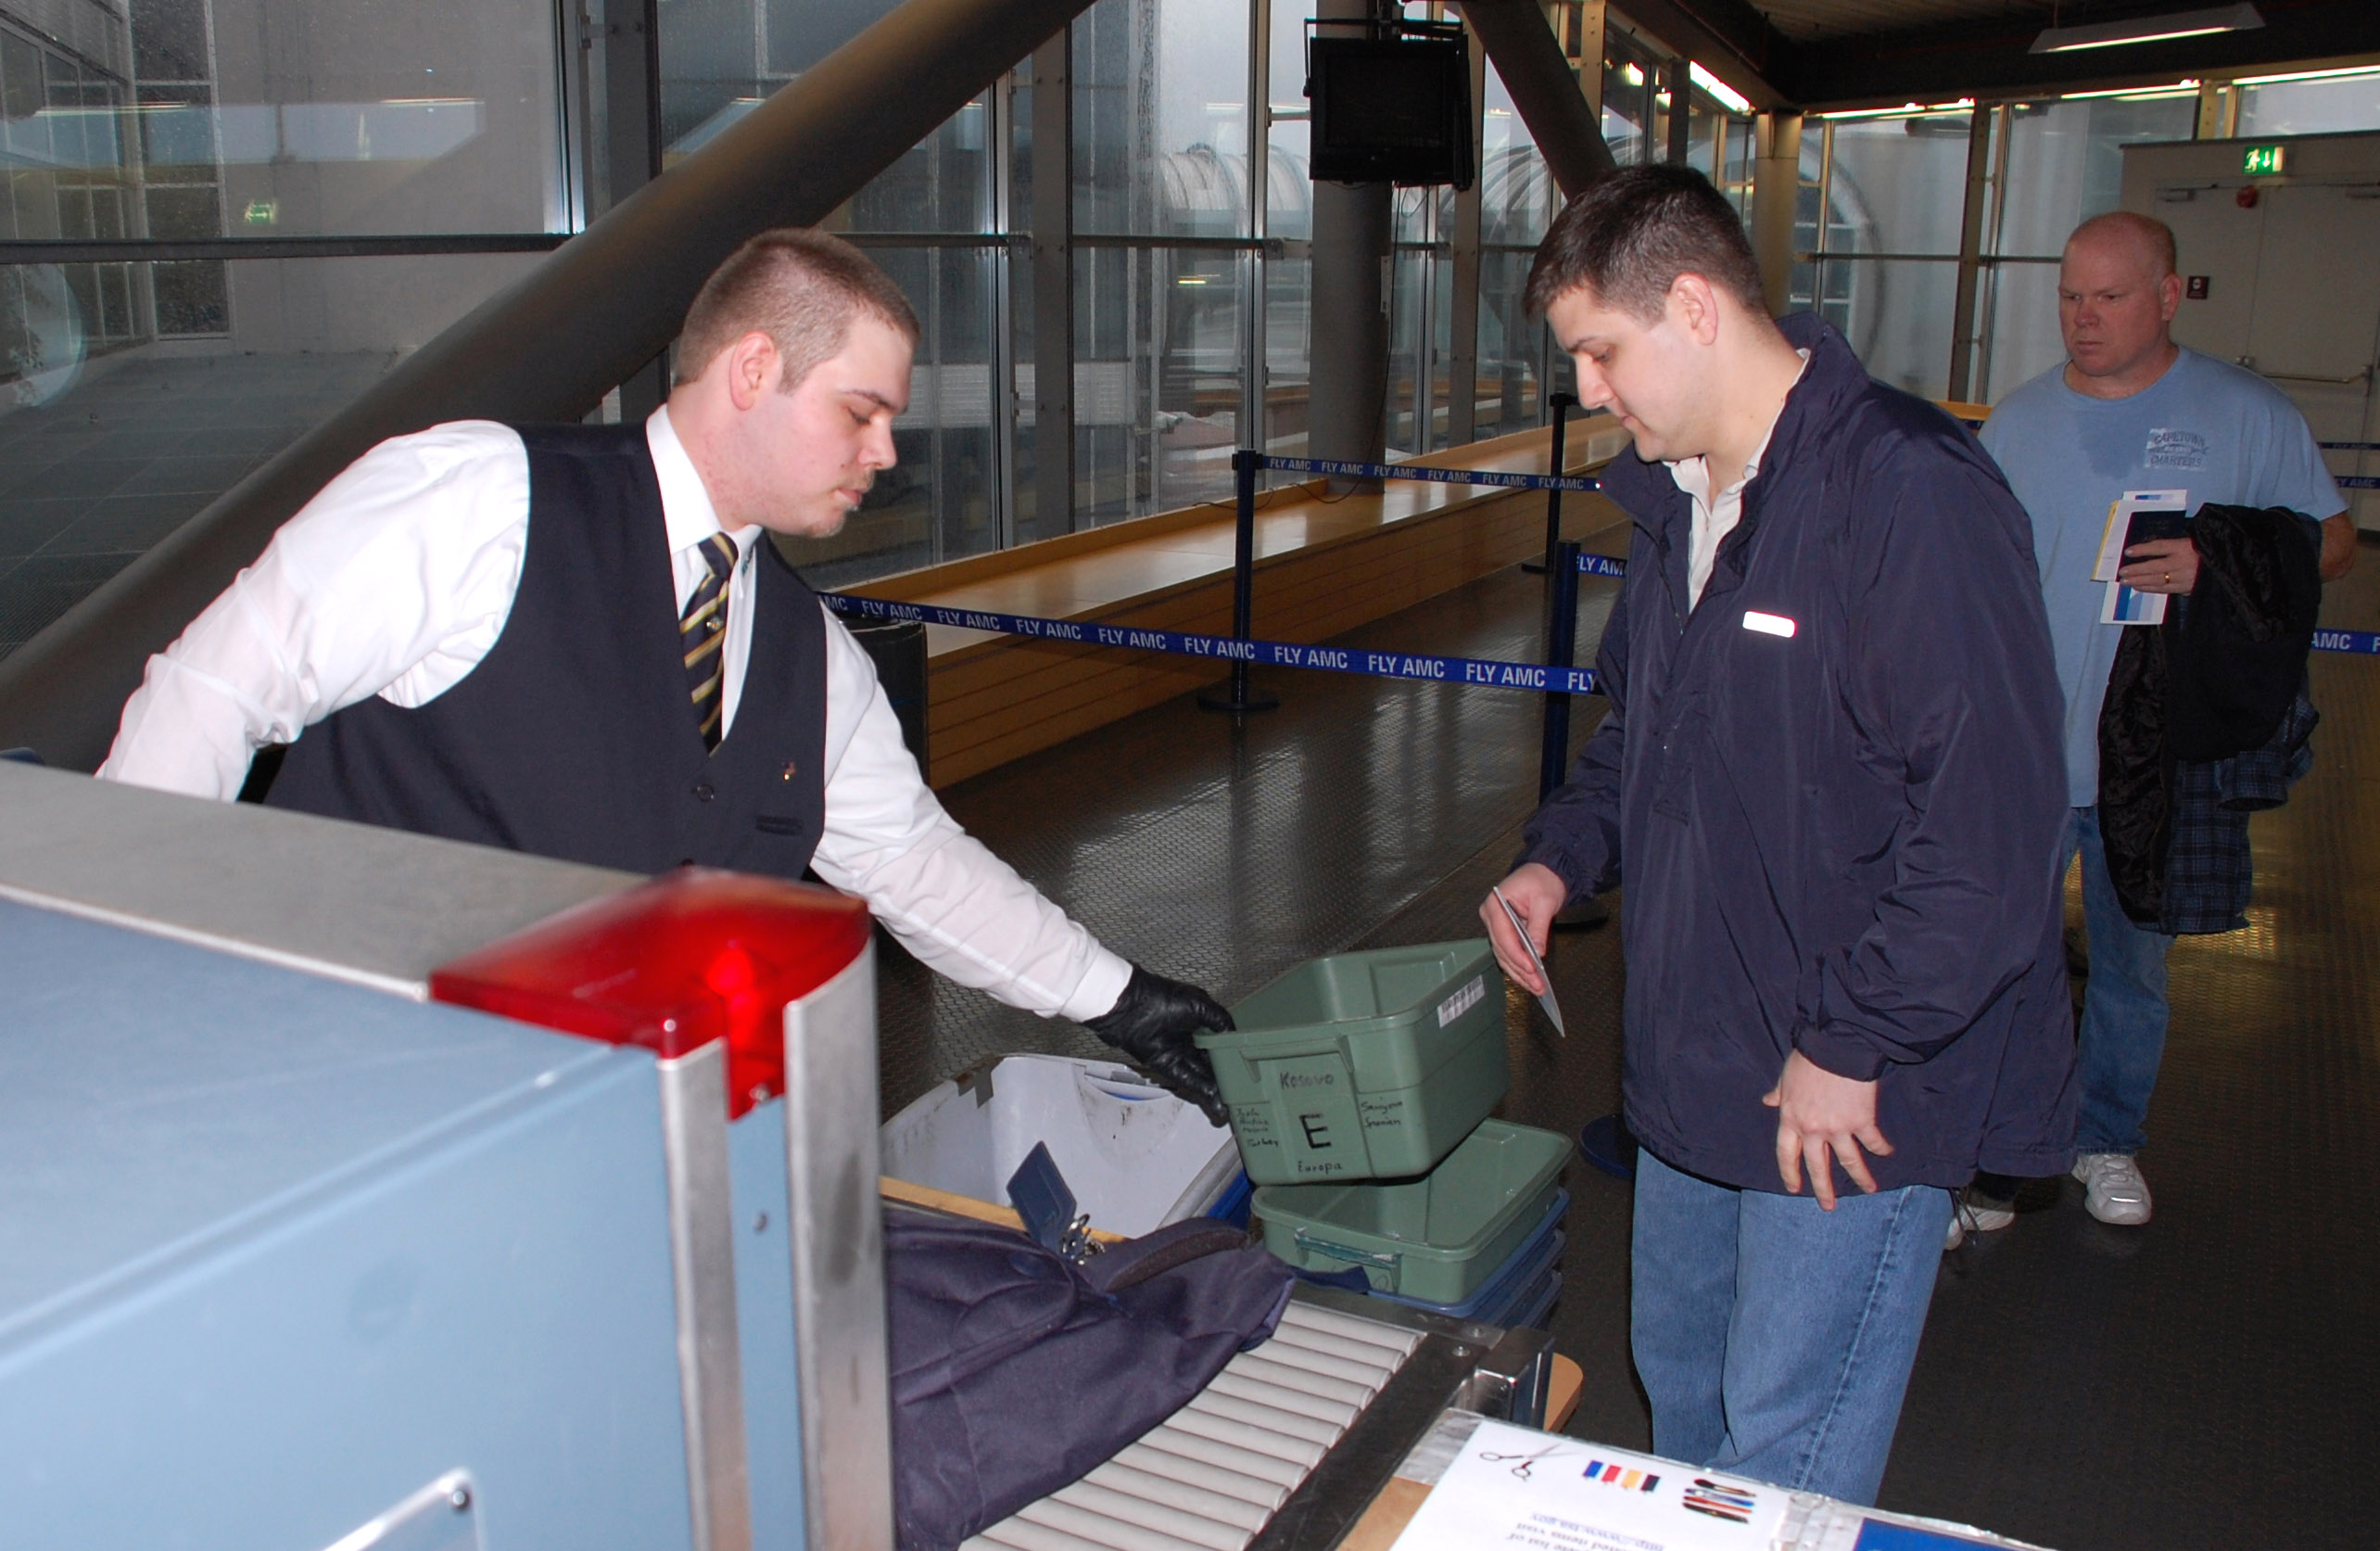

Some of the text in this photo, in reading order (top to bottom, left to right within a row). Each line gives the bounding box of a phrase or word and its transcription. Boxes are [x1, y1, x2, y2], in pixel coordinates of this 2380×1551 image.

[2150, 454, 2202, 468] CHARTERS
[1270, 458, 1584, 489] FLY AMC FLY AMC FLY AMC FLY AMC FLY AMC FLY AMC
[1599, 559, 1625, 576] AM
[861, 600, 884, 616] FLY
[890, 604, 923, 620] AMC
[937, 610, 960, 625] FLY
[966, 615, 1000, 630] AMC
[1016, 619, 1040, 634] FLY
[1046, 623, 1082, 640] AMC
[1098, 628, 1123, 644] FLY
[1129, 632, 1166, 650] AMC
[1184, 637, 1210, 655] FLY
[1217, 641, 1256, 660] AMC
[1274, 646, 1302, 664] FLY
[1308, 650, 1348, 668] AMC
[1368, 655, 1397, 673] FLY
[1402, 658, 1445, 678] AMC
[1465, 663, 1496, 682] FLY
[1500, 667, 1546, 687] AMC
[1280, 1072, 1335, 1090] Kosovo
[1299, 1113, 1332, 1149] E
[1298, 1161, 1344, 1176] Europa
